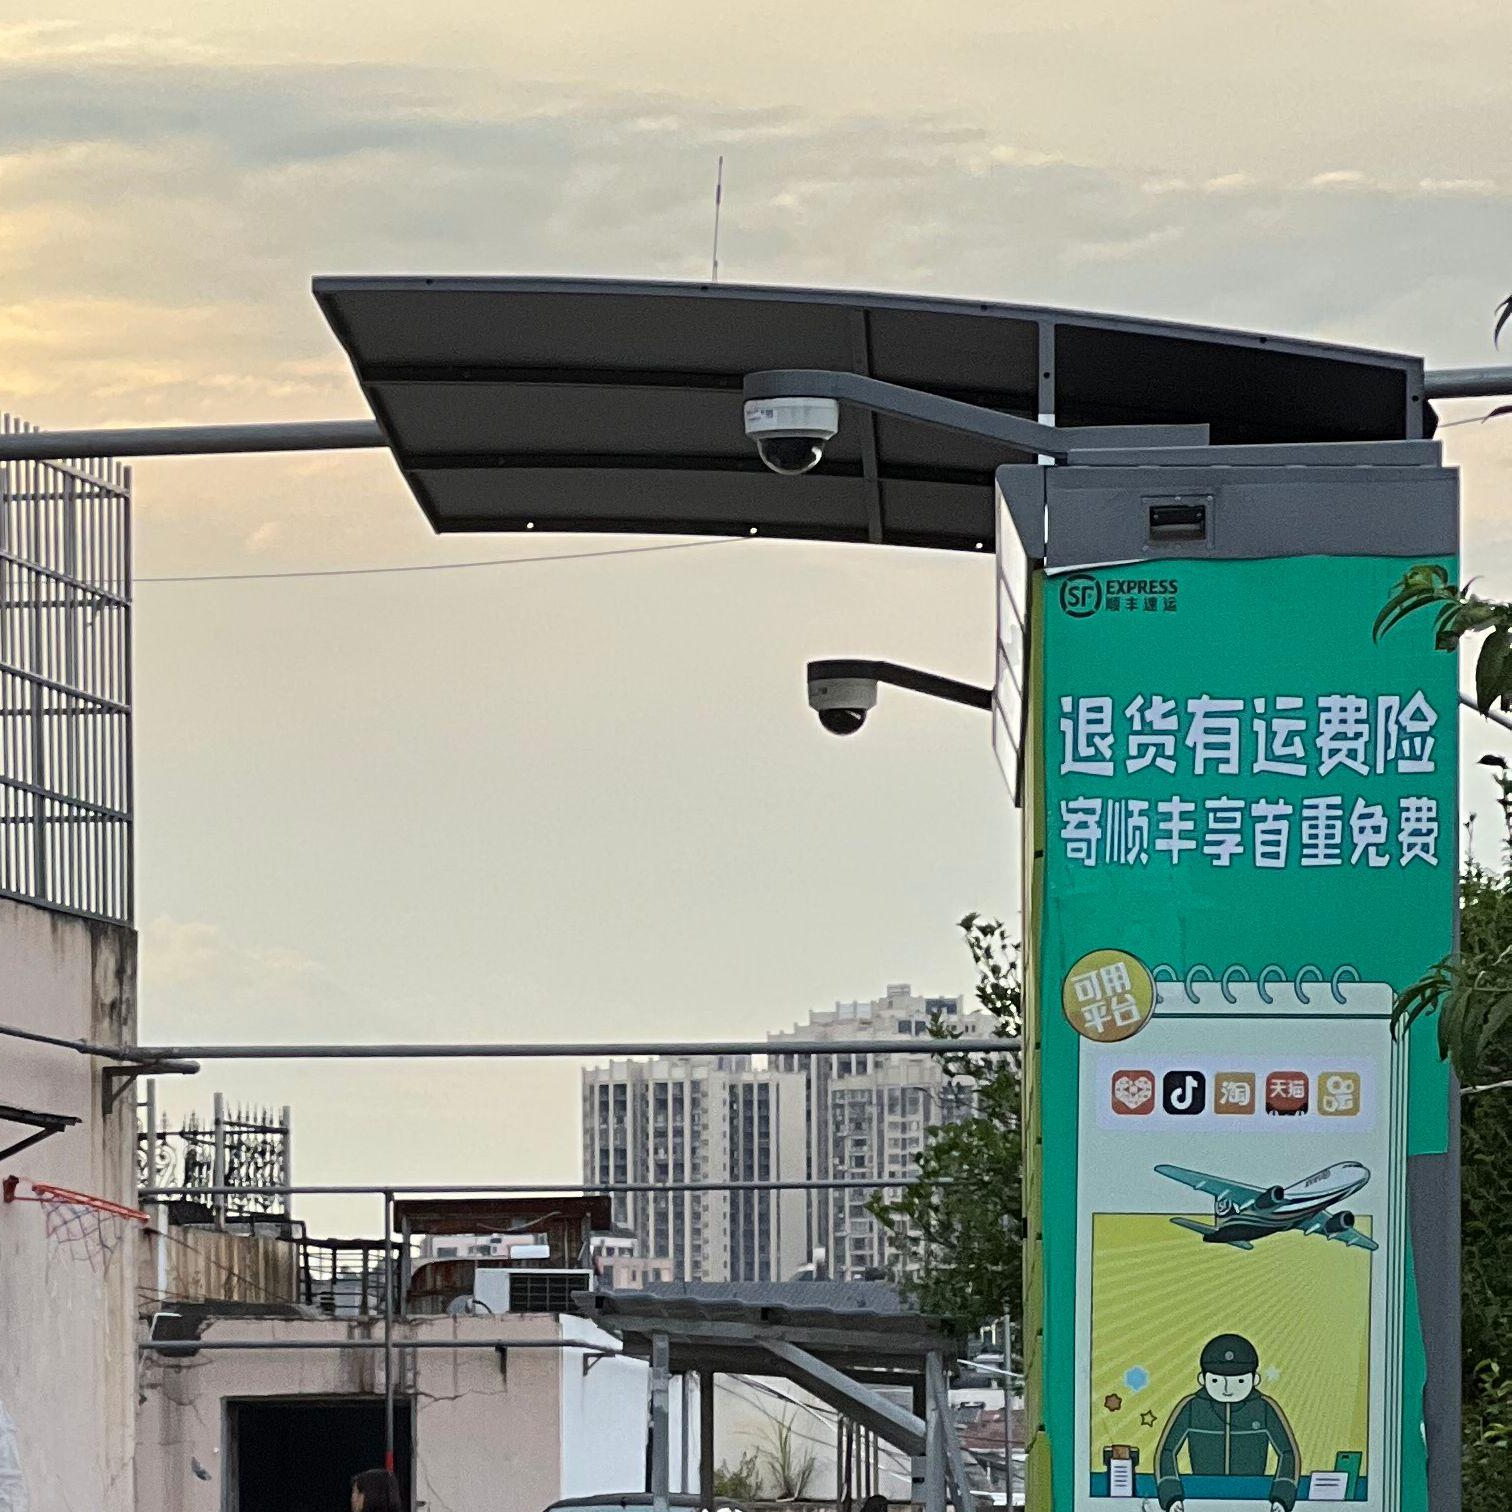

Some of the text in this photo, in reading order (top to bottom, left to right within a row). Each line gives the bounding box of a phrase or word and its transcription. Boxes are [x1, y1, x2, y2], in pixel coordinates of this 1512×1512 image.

[1068, 586, 1094, 608] SF
[1106, 579, 1178, 595] EXPRESS
[1105, 597, 1178, 612] 顺丰速运
[1060, 690, 1438, 777] 退货有运费险
[1060, 796, 1439, 868] 寄顺丰享首重免费
[1071, 961, 1131, 1002] 可用
[1081, 993, 1141, 1033] 平台
[1219, 1081, 1251, 1105] 淘
[1269, 1079, 1305, 1098] 天猫
